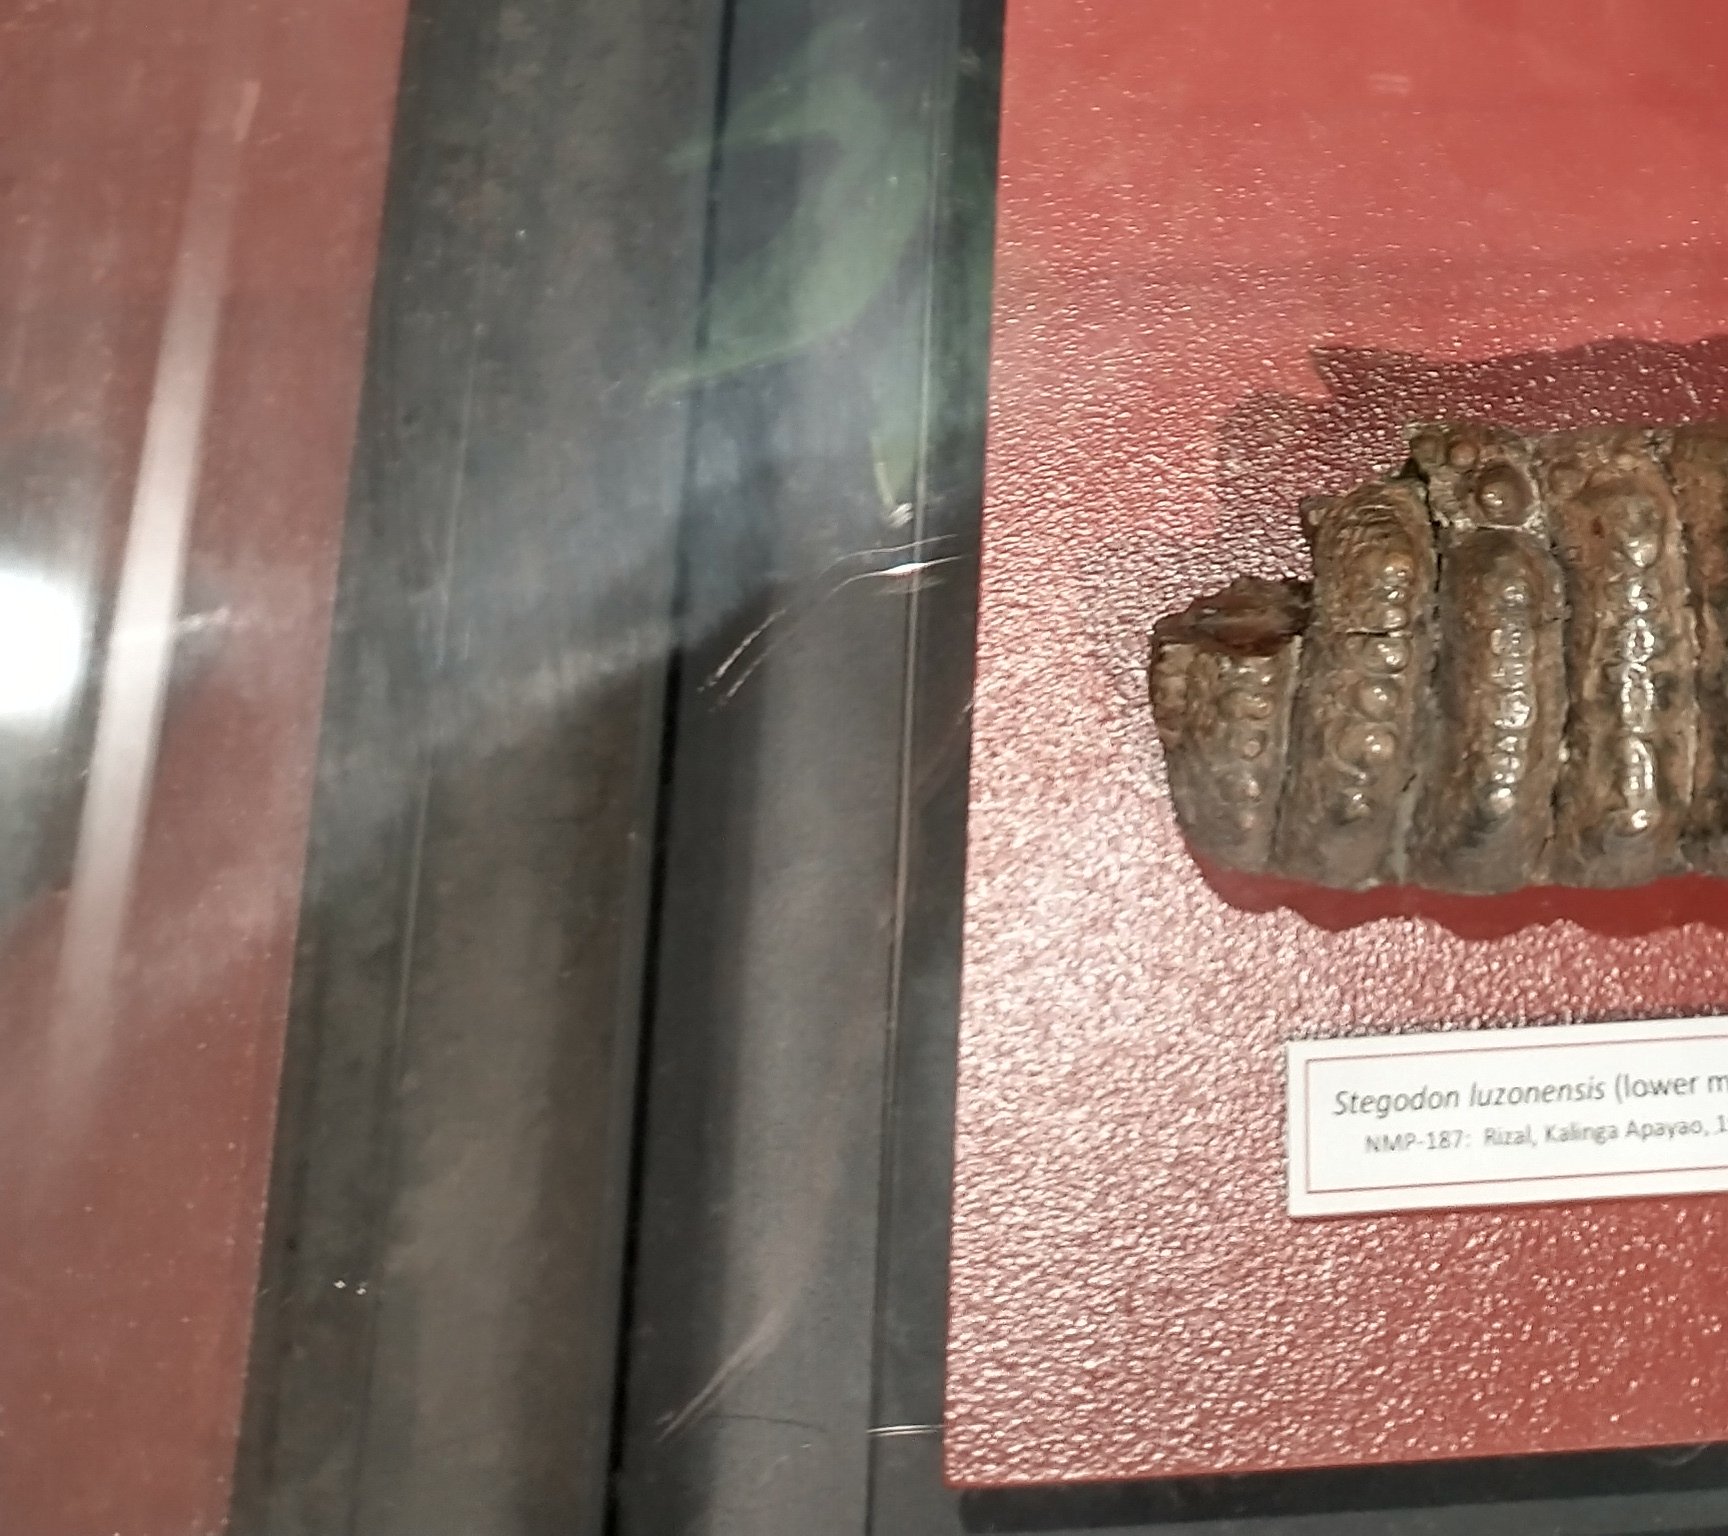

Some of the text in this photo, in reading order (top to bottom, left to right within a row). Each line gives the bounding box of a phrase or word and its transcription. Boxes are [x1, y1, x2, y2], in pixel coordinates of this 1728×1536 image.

[1332, 1087, 1460, 1119] Stegodon
[1470, 1076, 1605, 1107] luzonensis
[1615, 1071, 1699, 1105] (lower
[1365, 1128, 1471, 1153] NMP-187:
[1483, 1123, 1537, 1148] Rizal,
[1544, 1119, 1618, 1145] Kalinga
[1625, 1116, 1709, 1142] Apayao,
